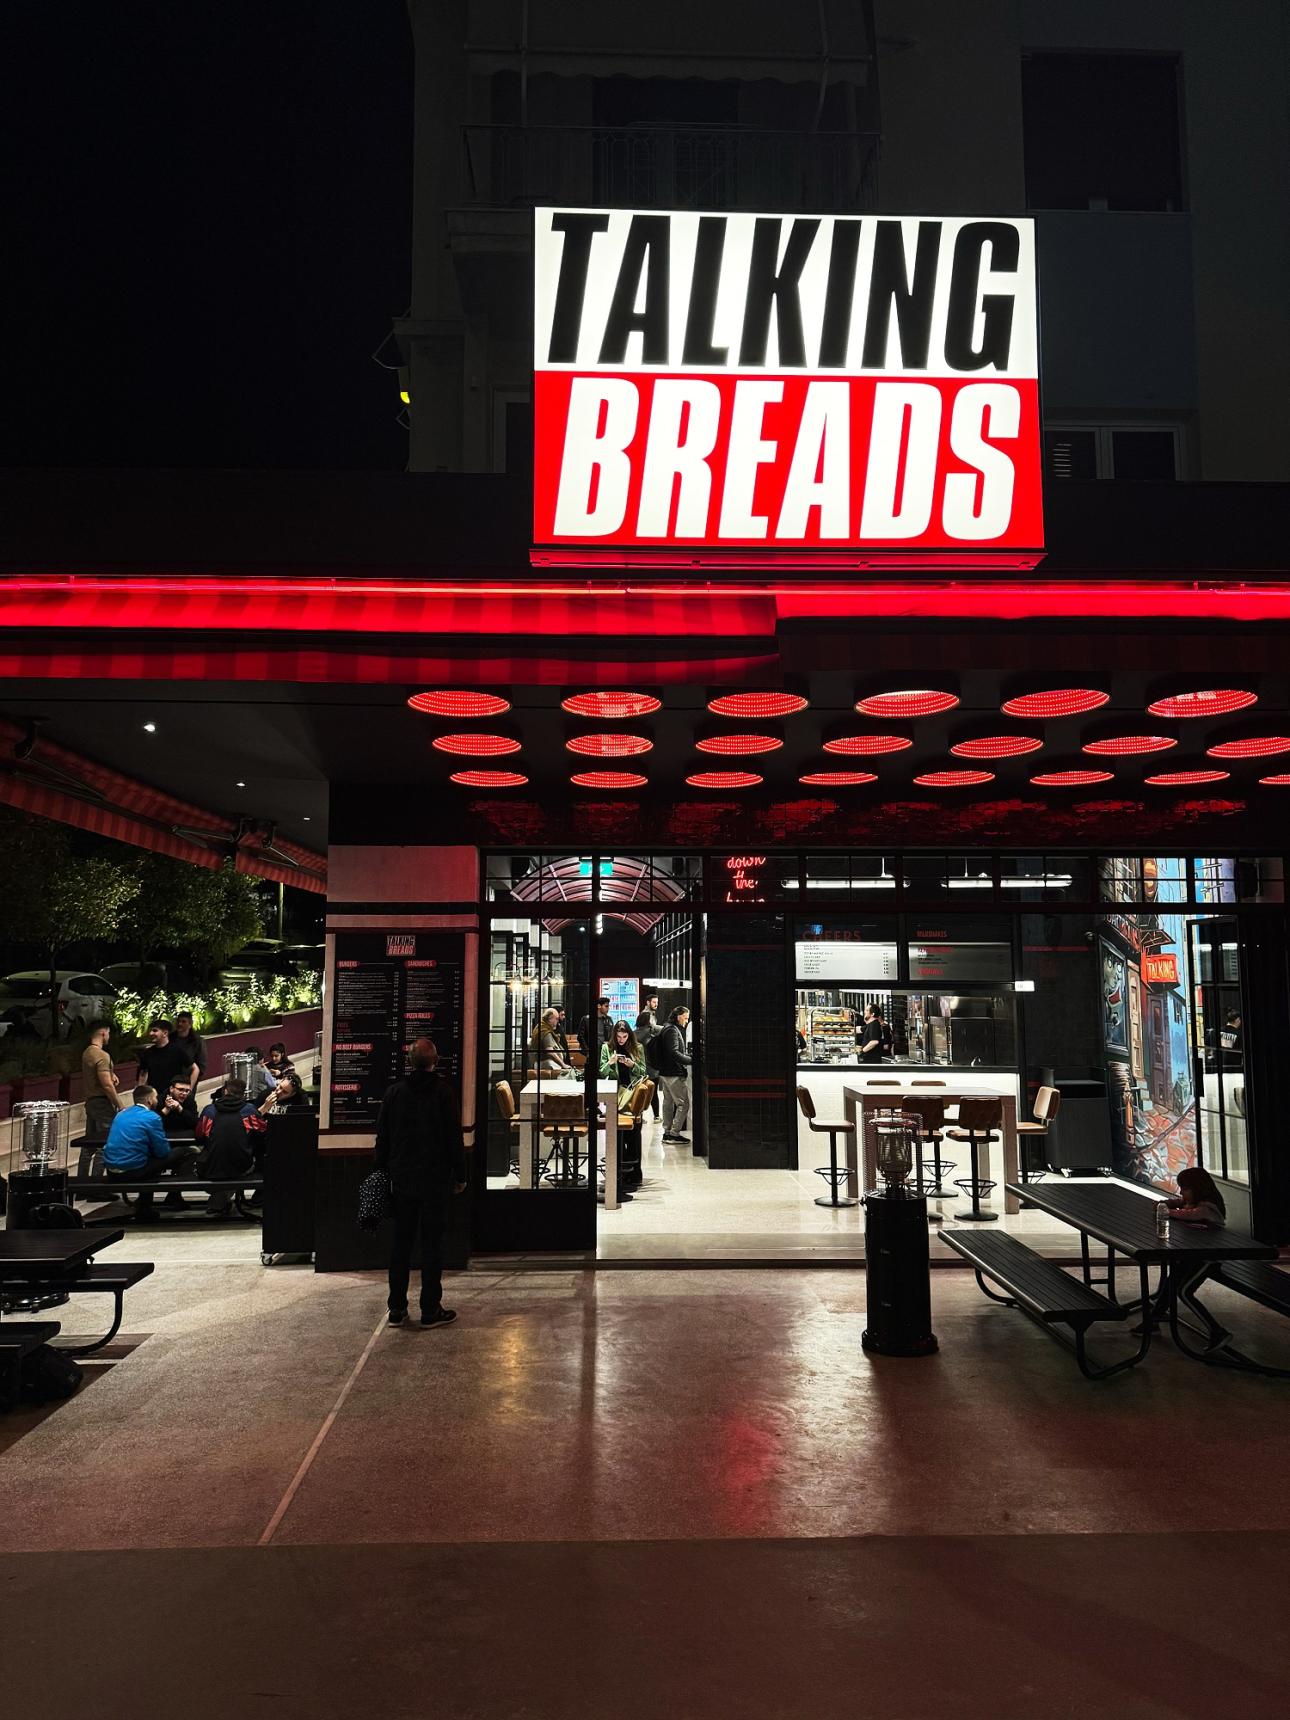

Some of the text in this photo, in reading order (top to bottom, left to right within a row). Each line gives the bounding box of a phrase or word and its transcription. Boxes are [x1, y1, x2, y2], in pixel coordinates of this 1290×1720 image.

[547, 212, 1021, 372] TALKING
[553, 377, 1021, 540] BREADS
[727, 856, 766, 868] down
[732, 870, 758, 889] the
[387, 935, 415, 946] TALKING
[388, 945, 414, 955] BREADS
[1147, 960, 1175, 979] TALKING
